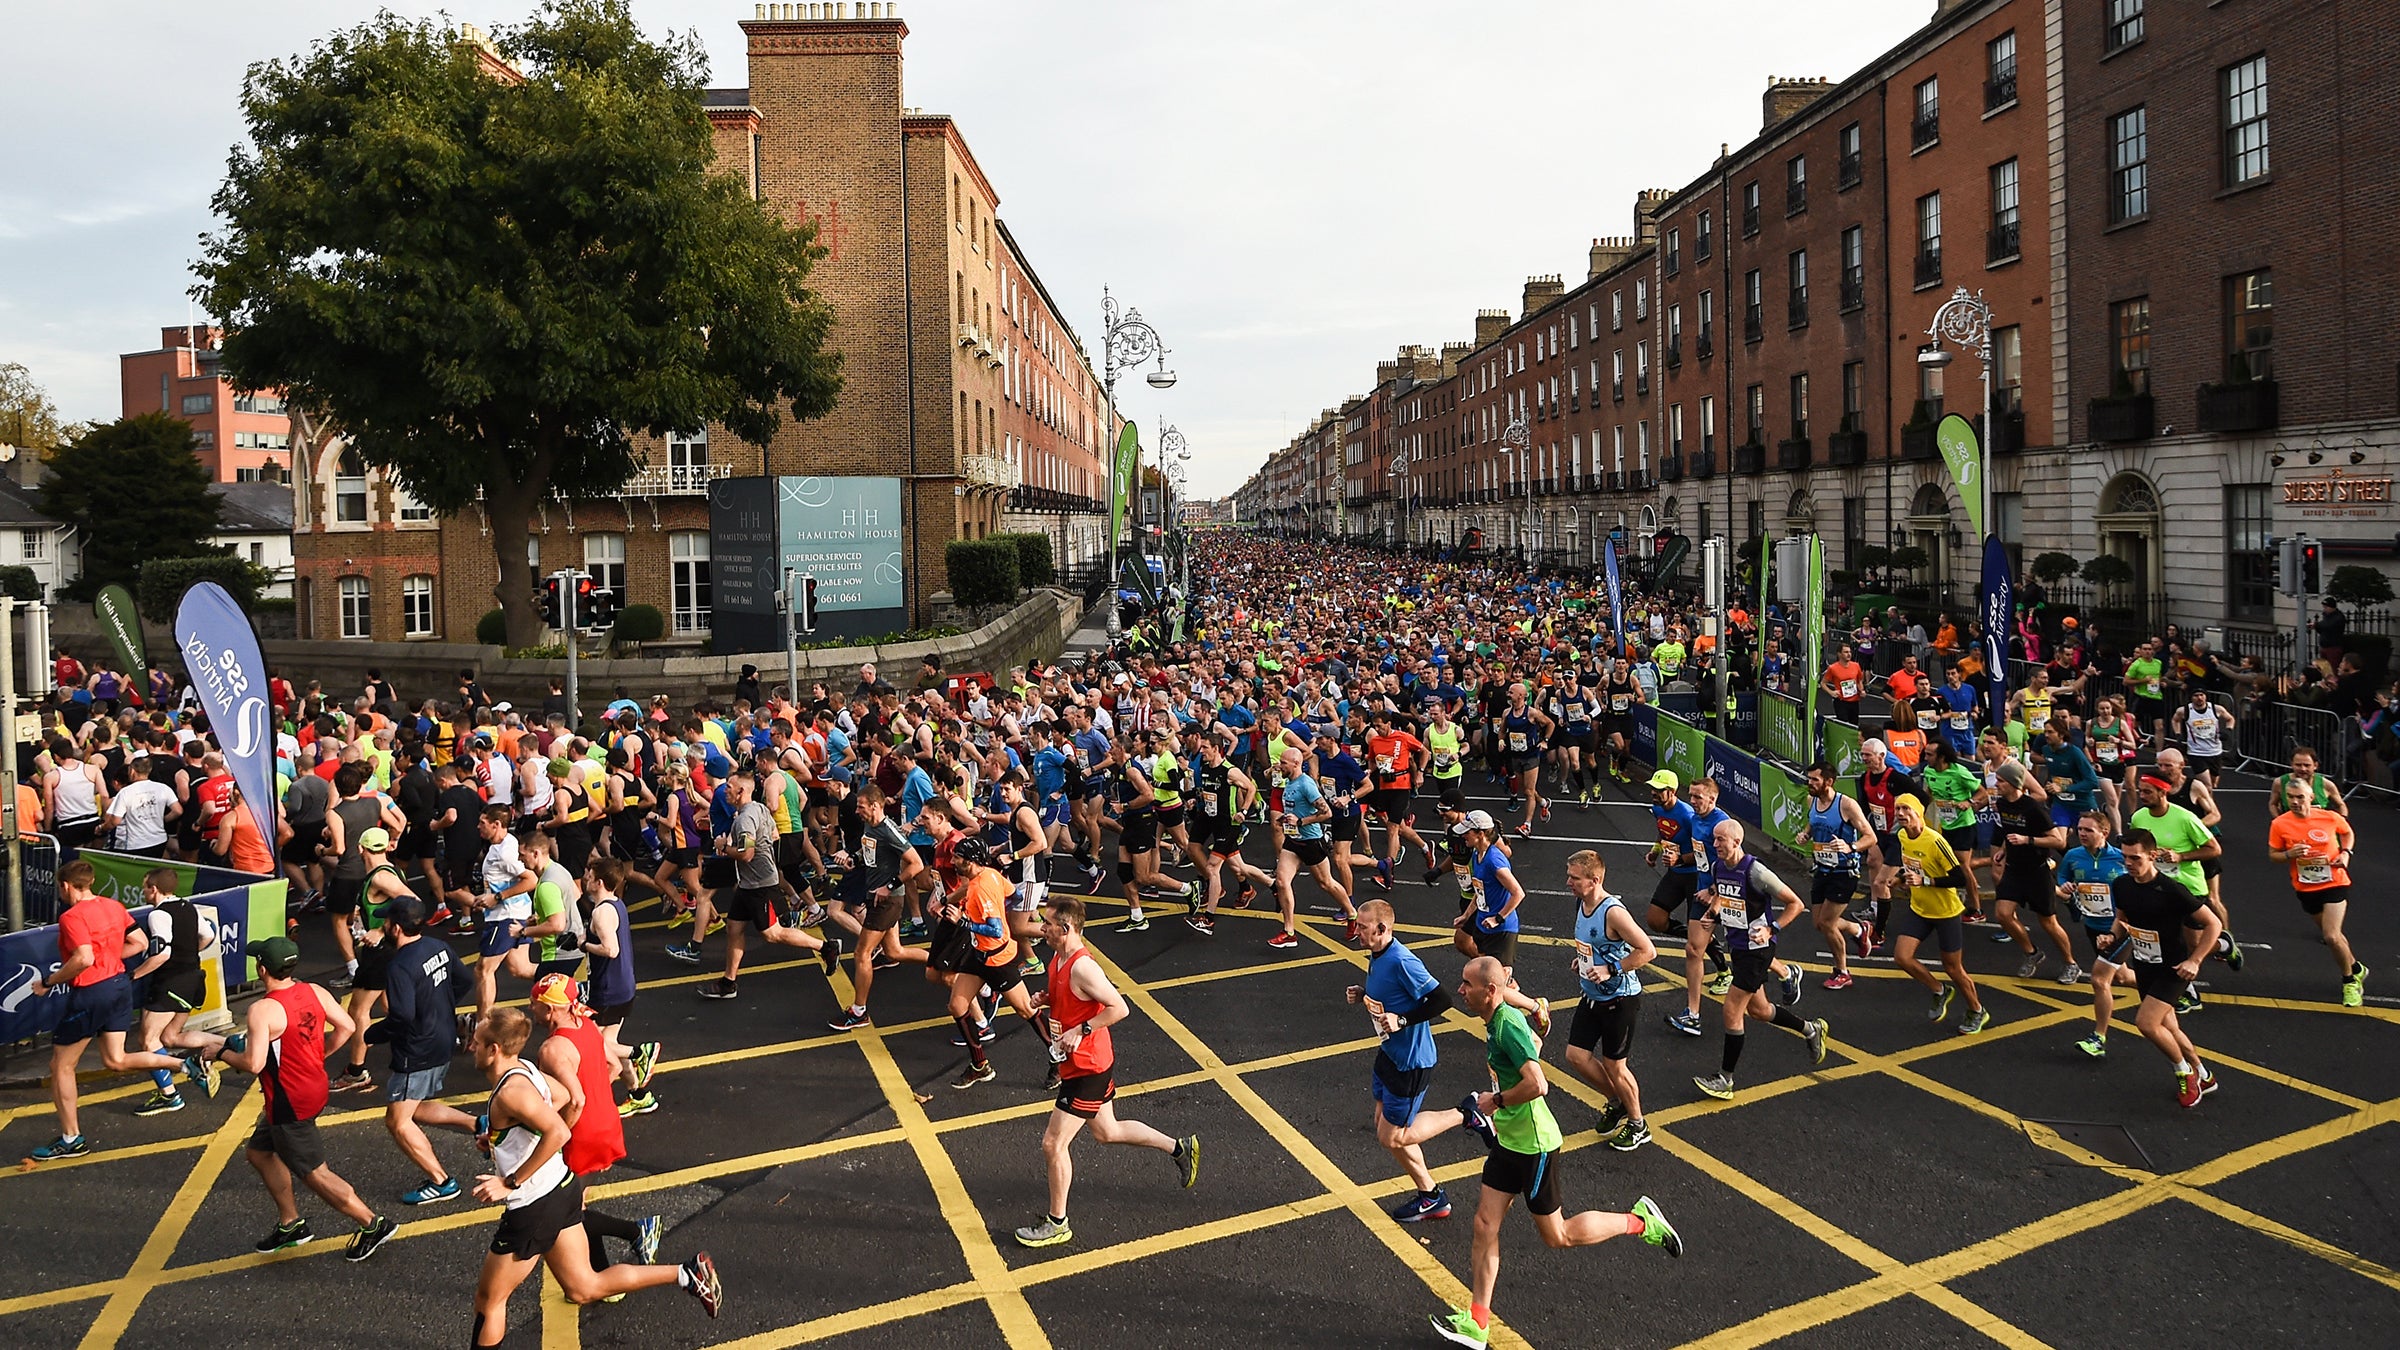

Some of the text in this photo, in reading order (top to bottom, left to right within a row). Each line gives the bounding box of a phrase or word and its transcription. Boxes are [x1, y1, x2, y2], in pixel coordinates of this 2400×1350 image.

[2283, 479, 2391, 502] SUESEY STREET
[798, 529, 898, 540] HAMILTON HOUSE
[785, 552, 862, 562] SUPERIOR SERVICED
[808, 562, 862, 572] OFFICE SUITES
[816, 577, 863, 587] ILABLE NOW
[820, 592, 862, 604] 661 0661
[1989, 592, 1998, 633] sse
[101, 593, 141, 665] Irish Independent
[1674, 739, 1687, 756] sse
[1715, 761, 1725, 774] sse
[1734, 770, 1759, 795] DUBLIN
[1718, 883, 1742, 897] GAZ
[1722, 907, 1742, 918] 4880
